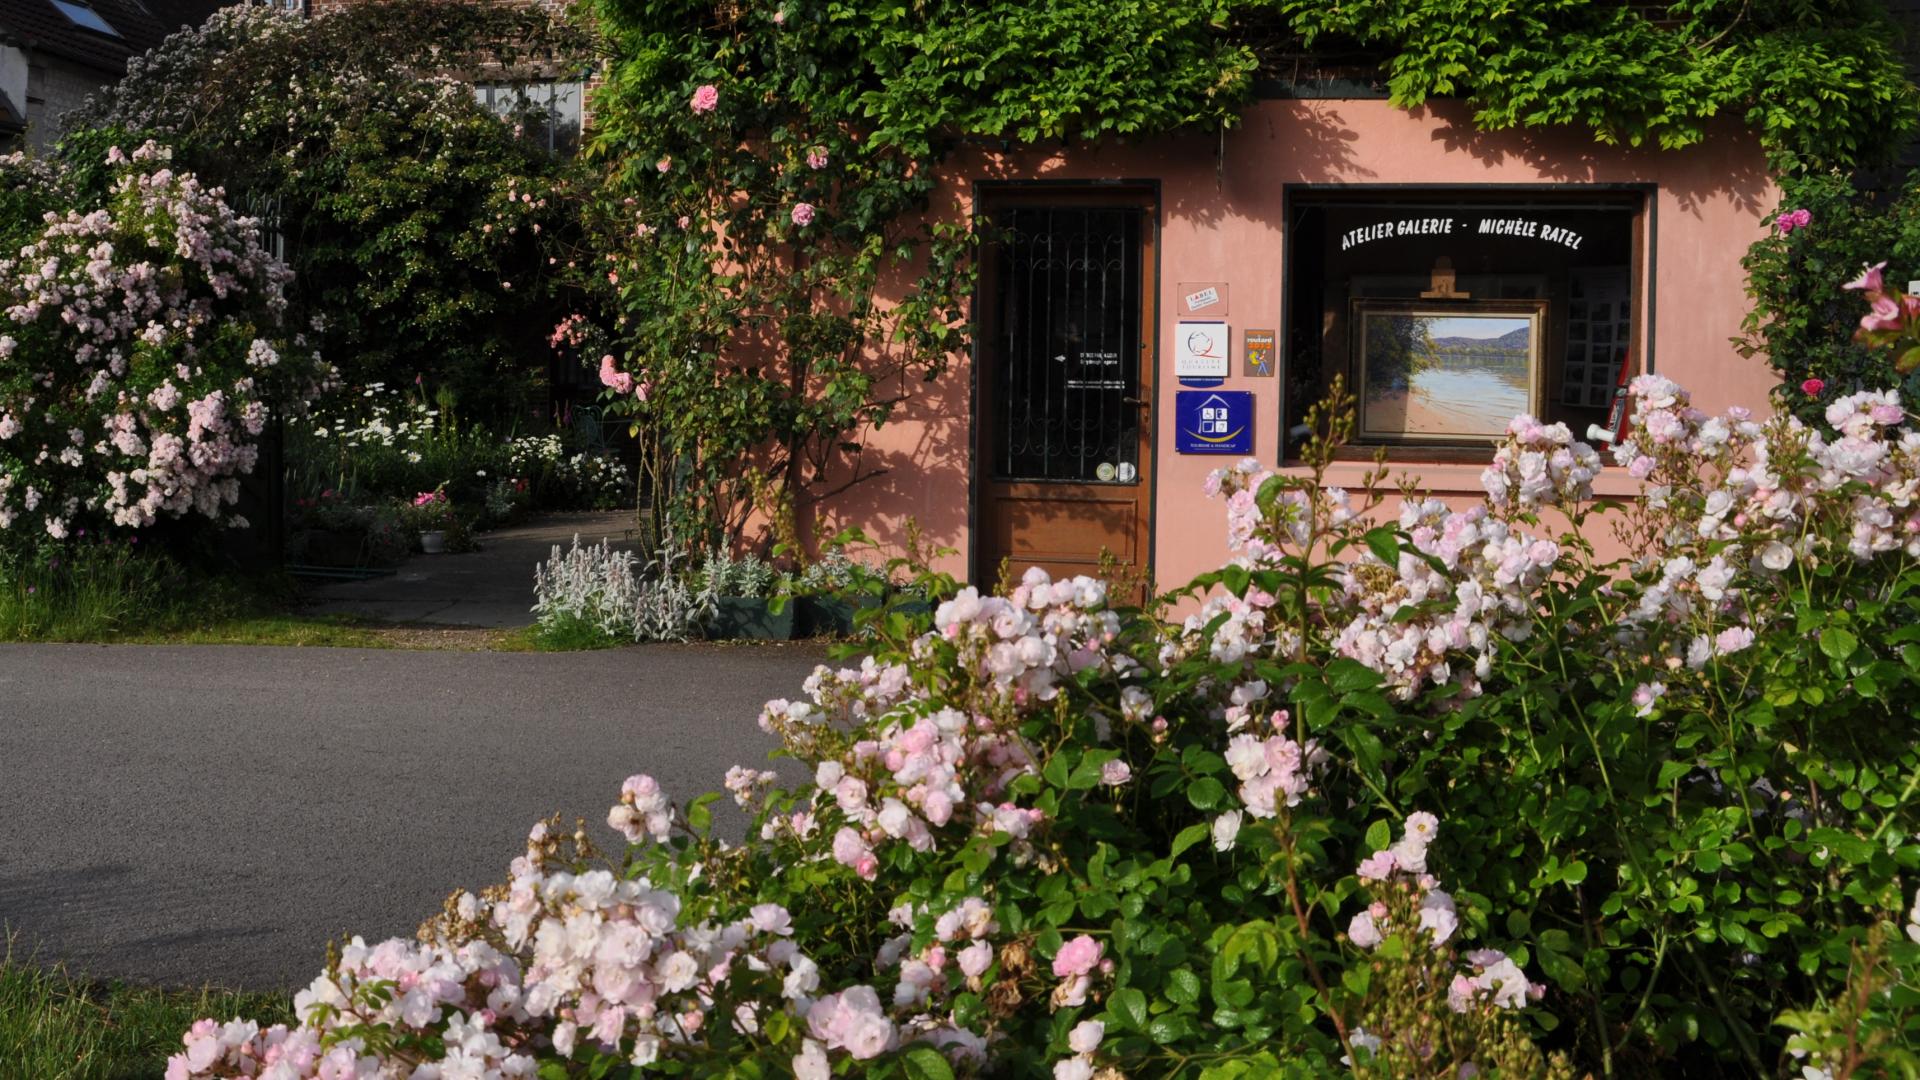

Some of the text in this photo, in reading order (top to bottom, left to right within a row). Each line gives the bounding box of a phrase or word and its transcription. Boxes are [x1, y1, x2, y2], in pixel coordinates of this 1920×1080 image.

[1341, 221, 1394, 251] ATELIER
[1396, 218, 1454, 236] GALERIE
[1478, 217, 1538, 238] MICHÈLE
[1539, 224, 1583, 250] RATEL
[1247, 335, 1272, 344] routard
